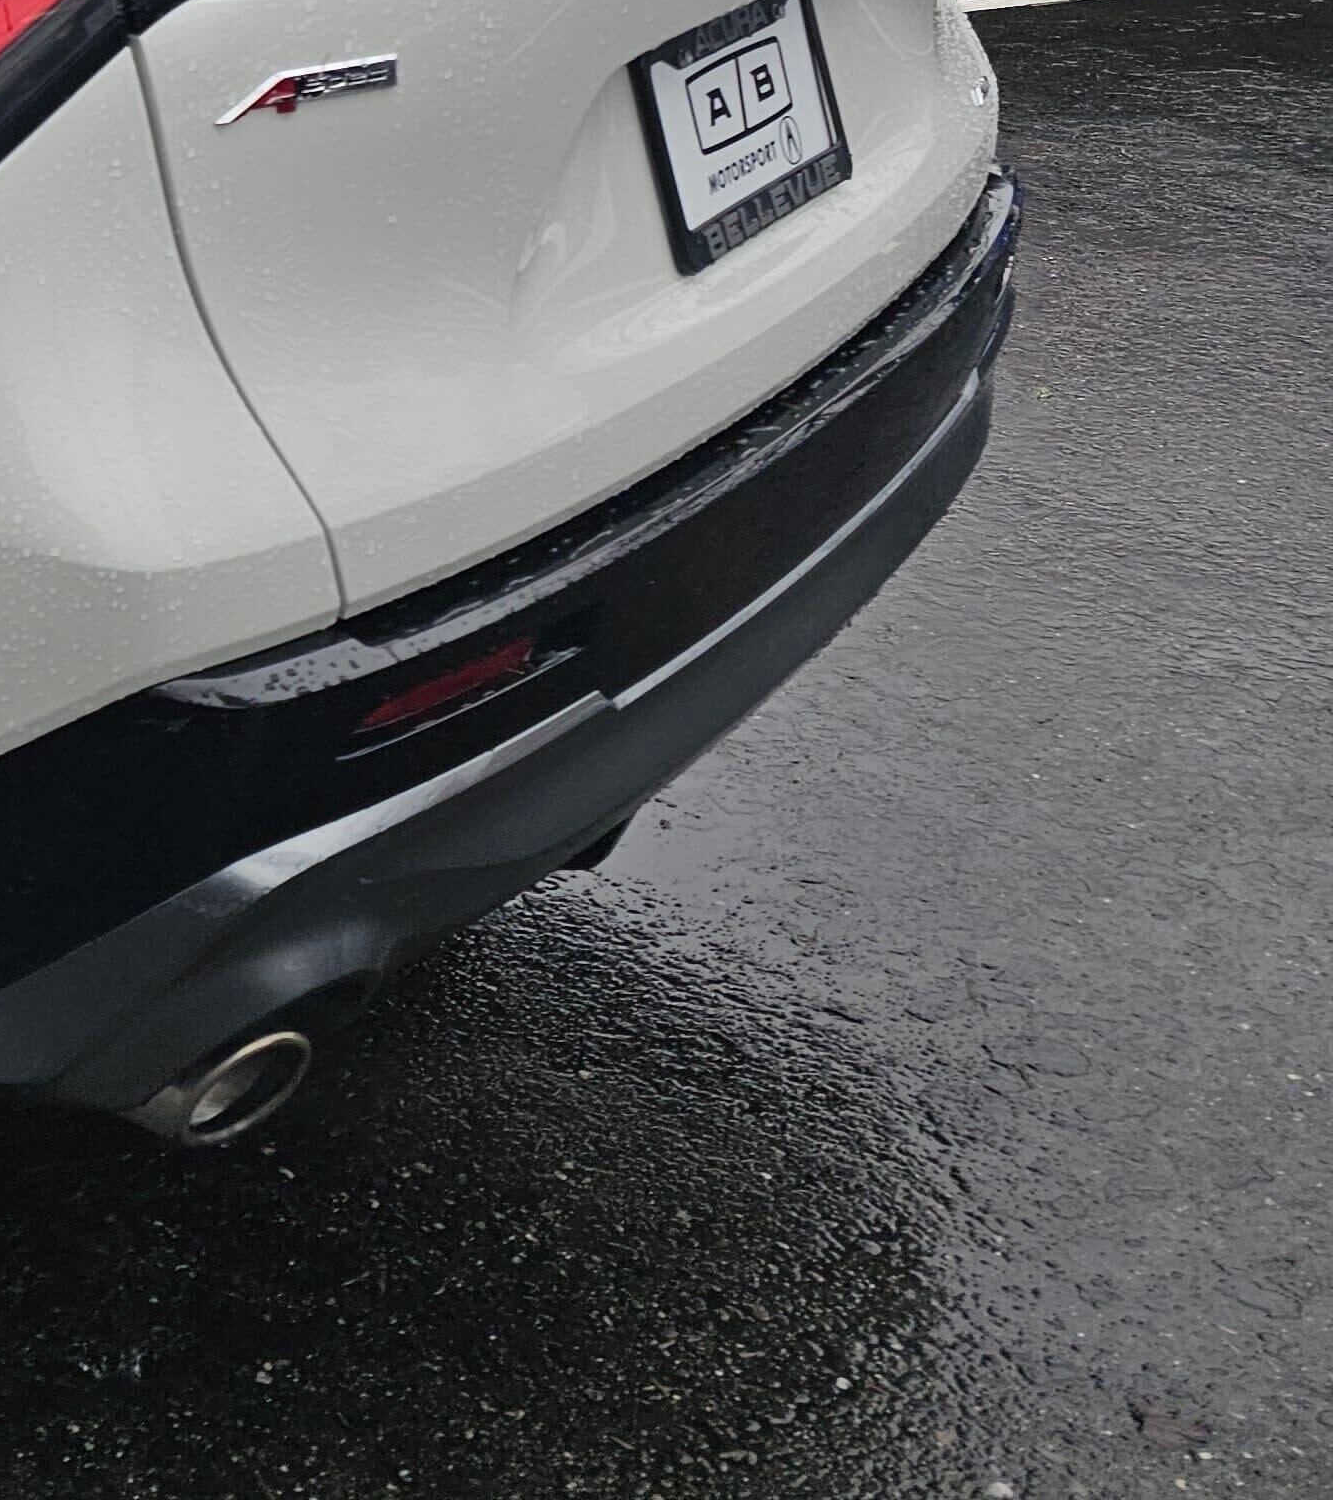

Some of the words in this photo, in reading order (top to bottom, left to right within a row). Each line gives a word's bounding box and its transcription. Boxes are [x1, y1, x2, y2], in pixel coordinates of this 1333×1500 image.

[694, 2, 770, 57] ACURA
[706, 87, 732, 127] A
[749, 63, 776, 102] B
[707, 140, 777, 196] MOTORSPORT
[702, 152, 842, 261] BELLEVUE
